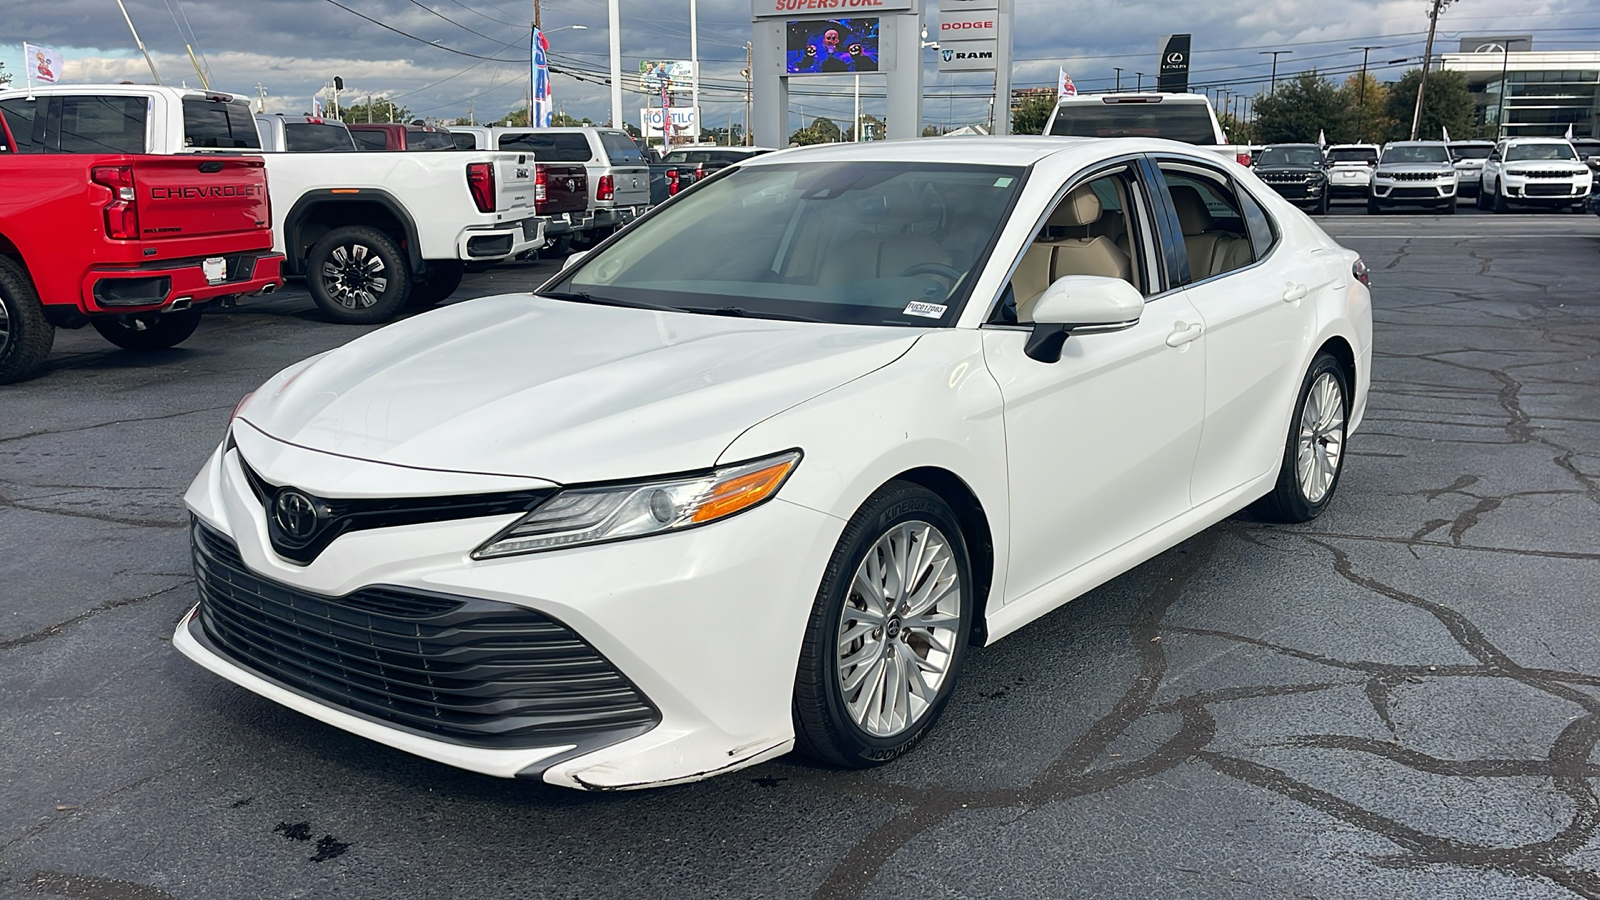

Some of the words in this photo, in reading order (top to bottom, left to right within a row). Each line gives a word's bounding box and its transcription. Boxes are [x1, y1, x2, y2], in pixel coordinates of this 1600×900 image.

[941, 21, 994, 31] DODGE
[956, 51, 993, 60] RAM
[643, 112, 695, 124] HOTILO
[151, 185, 263, 199] CHEVROLET
